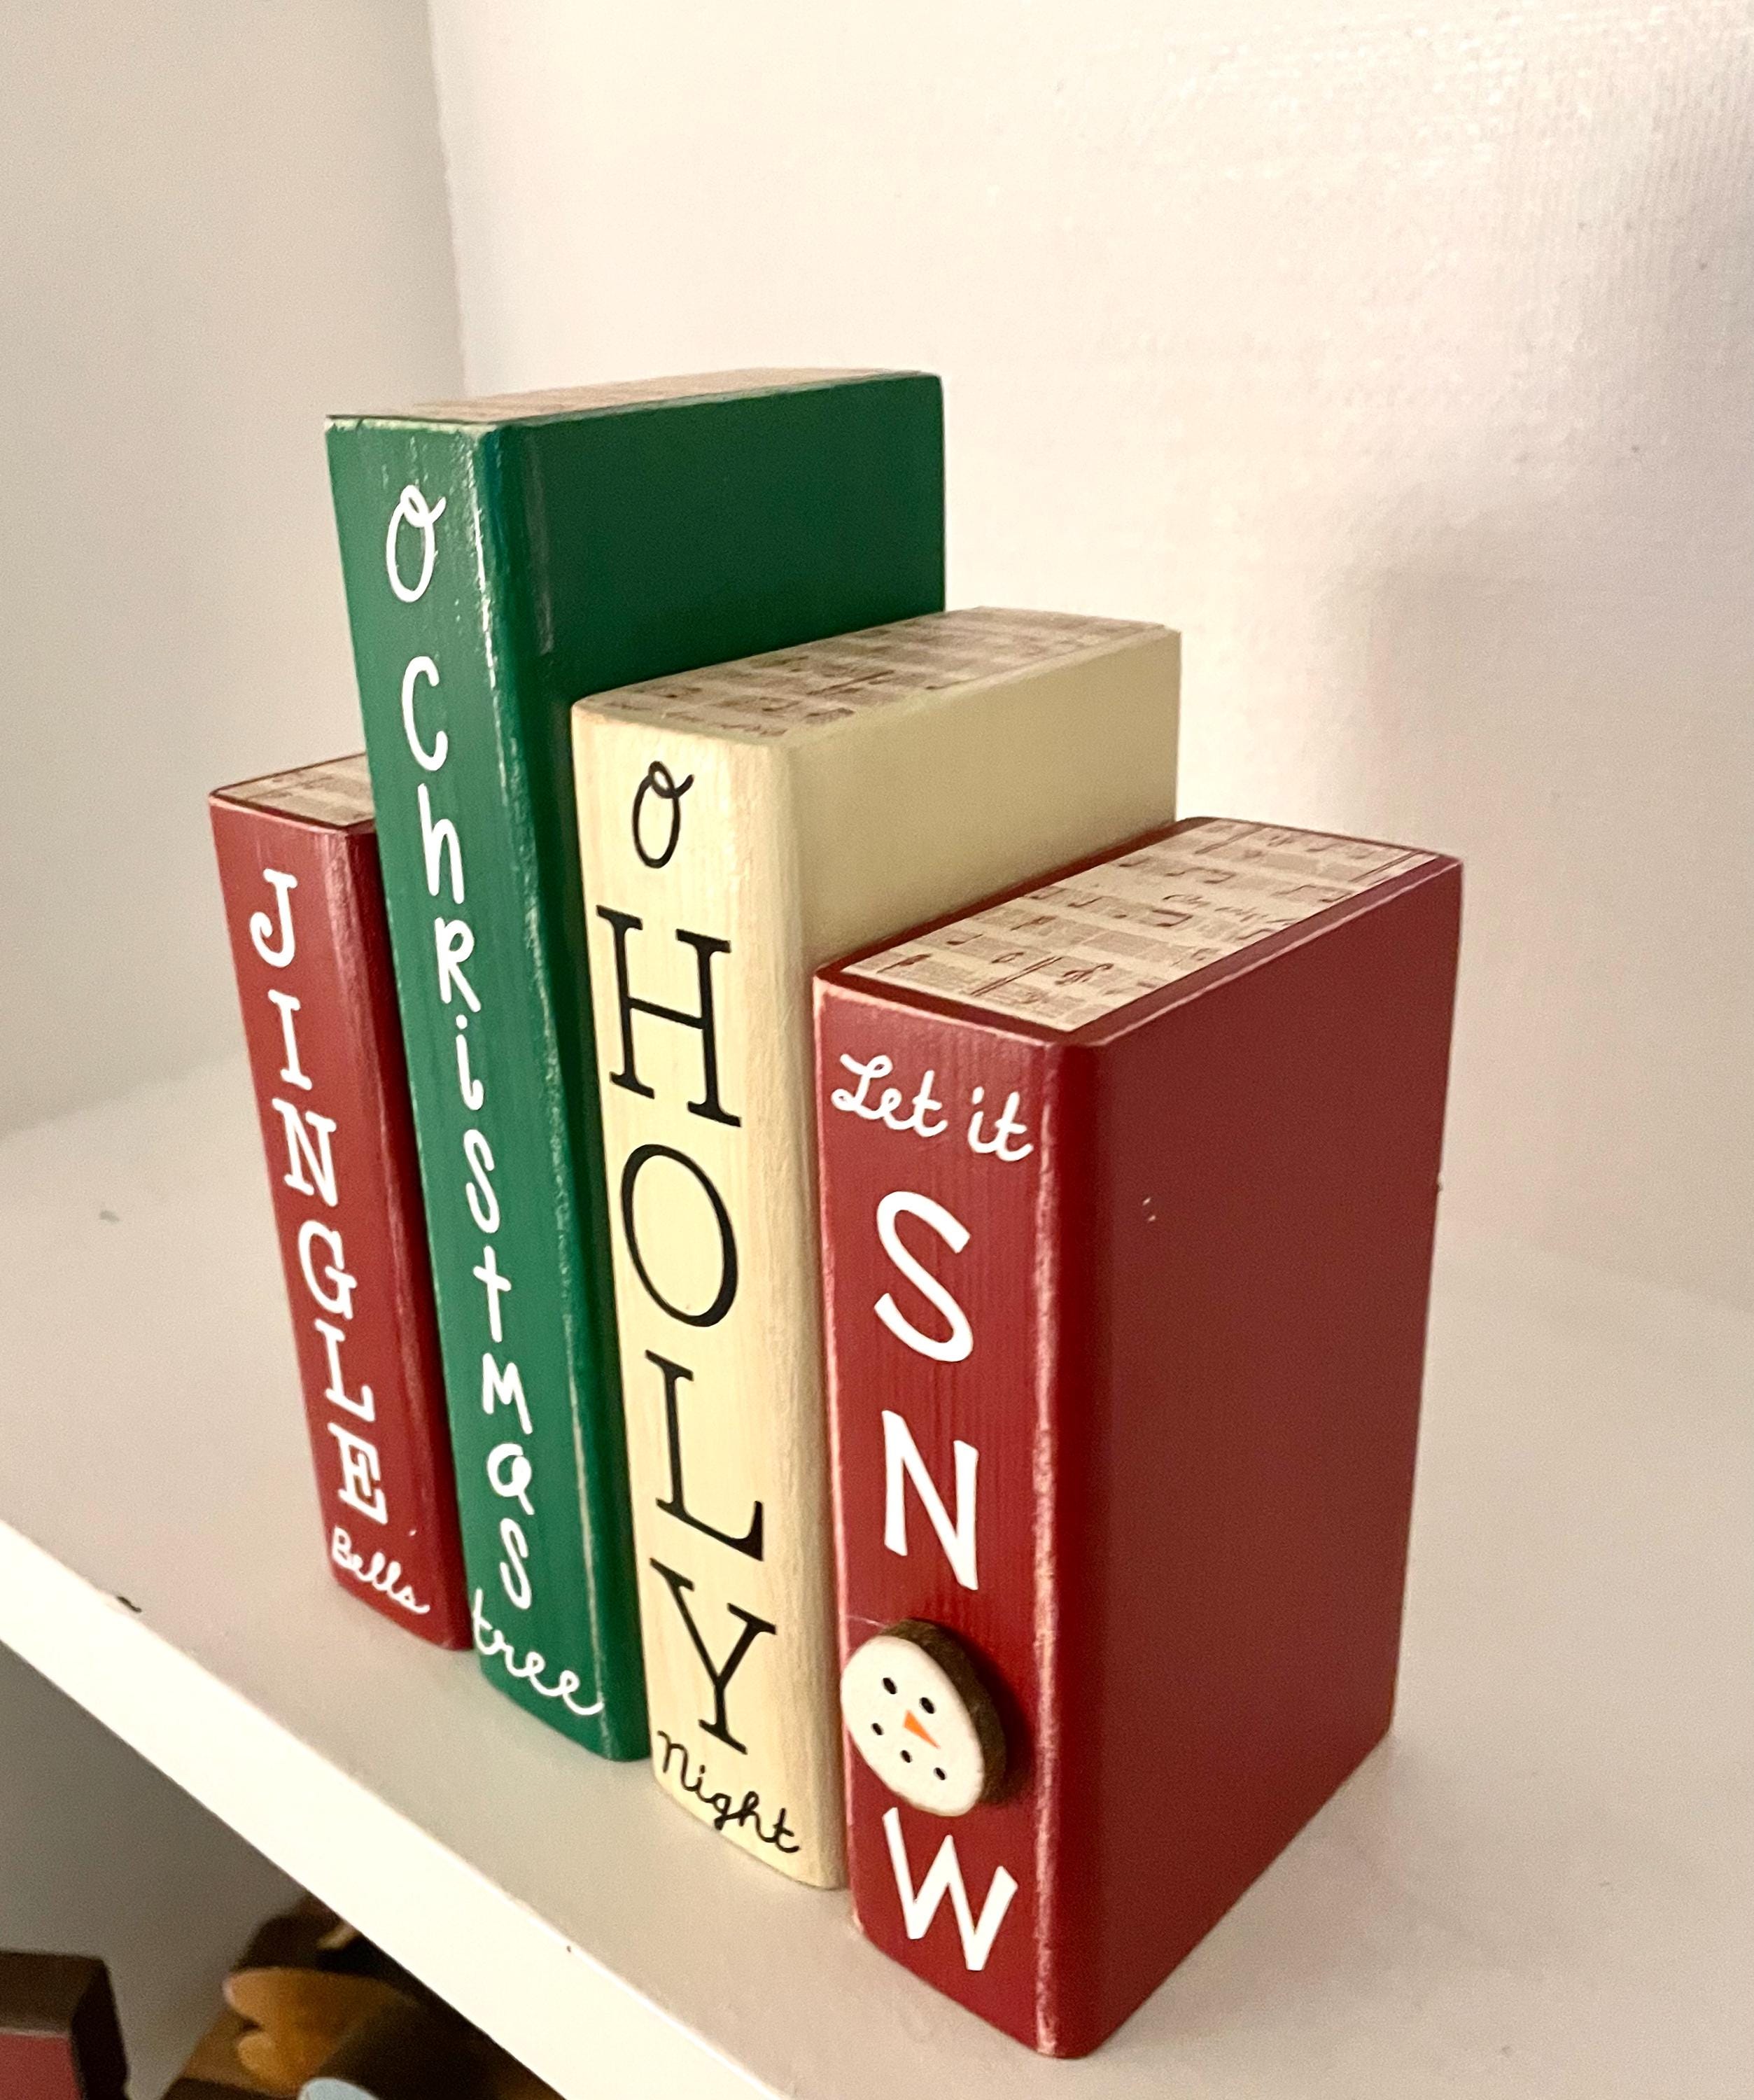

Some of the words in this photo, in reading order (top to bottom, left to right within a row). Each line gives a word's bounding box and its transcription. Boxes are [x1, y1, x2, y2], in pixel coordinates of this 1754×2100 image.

[386, 484, 446, 603] O
[631, 760, 694, 869] O
[831, 1054, 948, 1138] Let
[967, 1086, 1034, 1162] it
[249, 868, 388, 1525] JINGLE
[596, 904, 776, 1755] HOLY
[331, 1526, 430, 1614] Bells
[472, 1588, 605, 1715] tree
